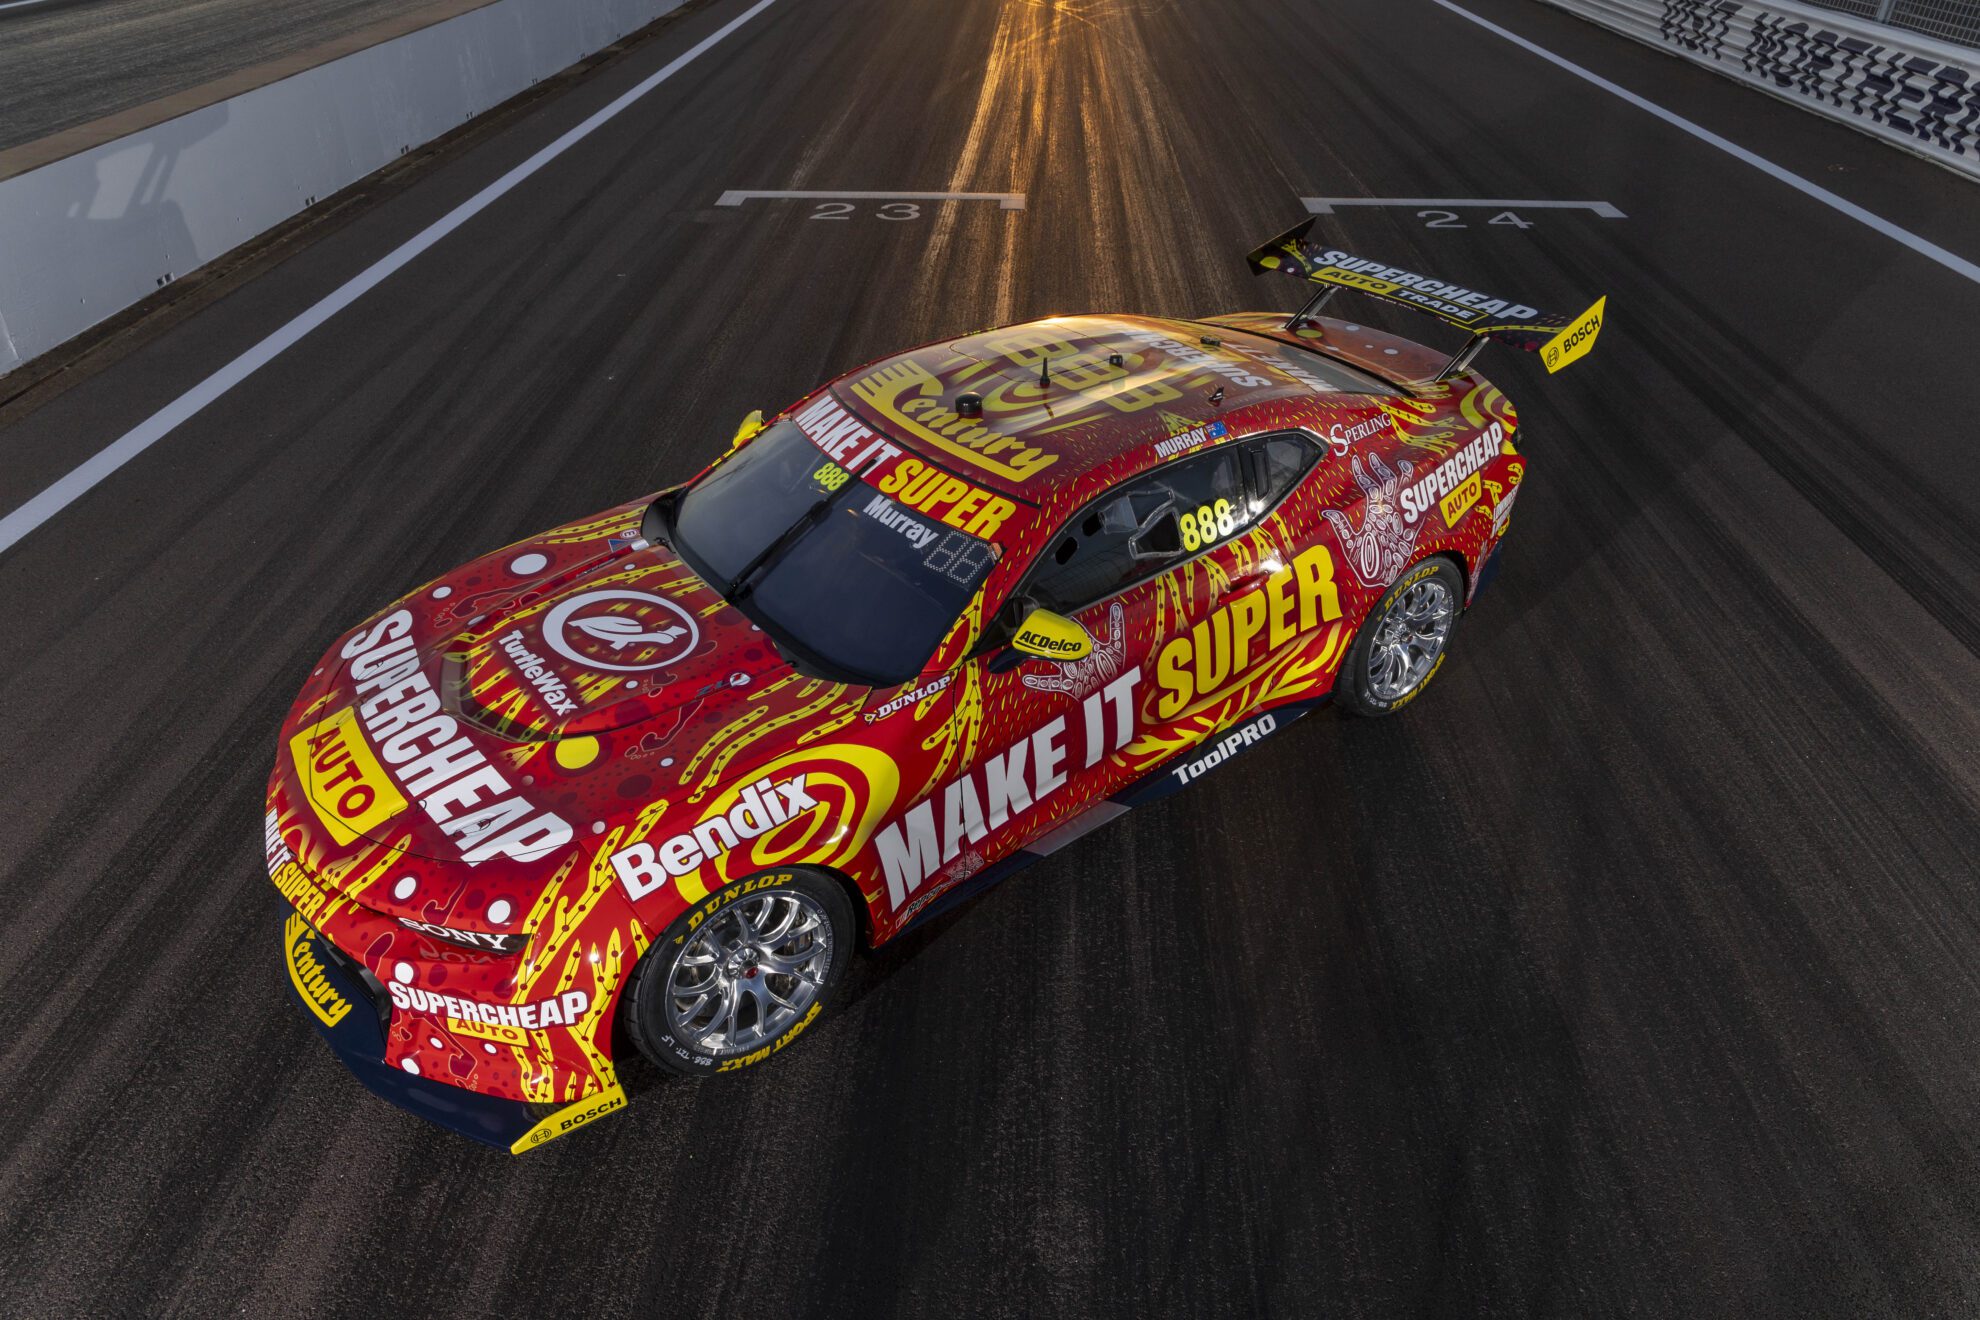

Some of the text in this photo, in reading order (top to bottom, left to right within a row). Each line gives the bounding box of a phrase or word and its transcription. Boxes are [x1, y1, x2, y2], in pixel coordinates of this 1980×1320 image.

[1417, 211, 1534, 229] 24
[1313, 250, 1539, 320] SUPERCHEAP
[1323, 270, 1388, 290] AUTO
[1398, 290, 1472, 320] TRADE
[1563, 315, 1601, 354] BOSCH
[795, 395, 1016, 540] MAKE IT SUPER
[1154, 427, 1207, 459] MURRAY
[813, 462, 850, 491] 888
[1400, 421, 1503, 524] SUPERCHEAP
[863, 494, 939, 550] Murray
[1180, 498, 1234, 551] 888
[1446, 481, 1478, 518] AUTO
[1385, 566, 1439, 611] DUNLOP
[1019, 630, 1082, 652] ACDelco
[878, 675, 951, 717] DUNLOP
[341, 609, 574, 868] SUPERCHEAP
[874, 544, 1344, 913] MAKE IT SUPER
[1172, 713, 1277, 785] ToolPRO
[306, 727, 376, 819] AUTO
[610, 774, 818, 902] Bendix
[274, 861, 326, 922] SUPER
[687, 873, 793, 934] DUNLOP
[398, 917, 509, 950] SONY
[388, 980, 590, 1030] SUPERCHEAP
[456, 1018, 519, 1041] AUTO
[773, 1001, 823, 1053] SPORT
[560, 1098, 623, 1130] BOSCH
